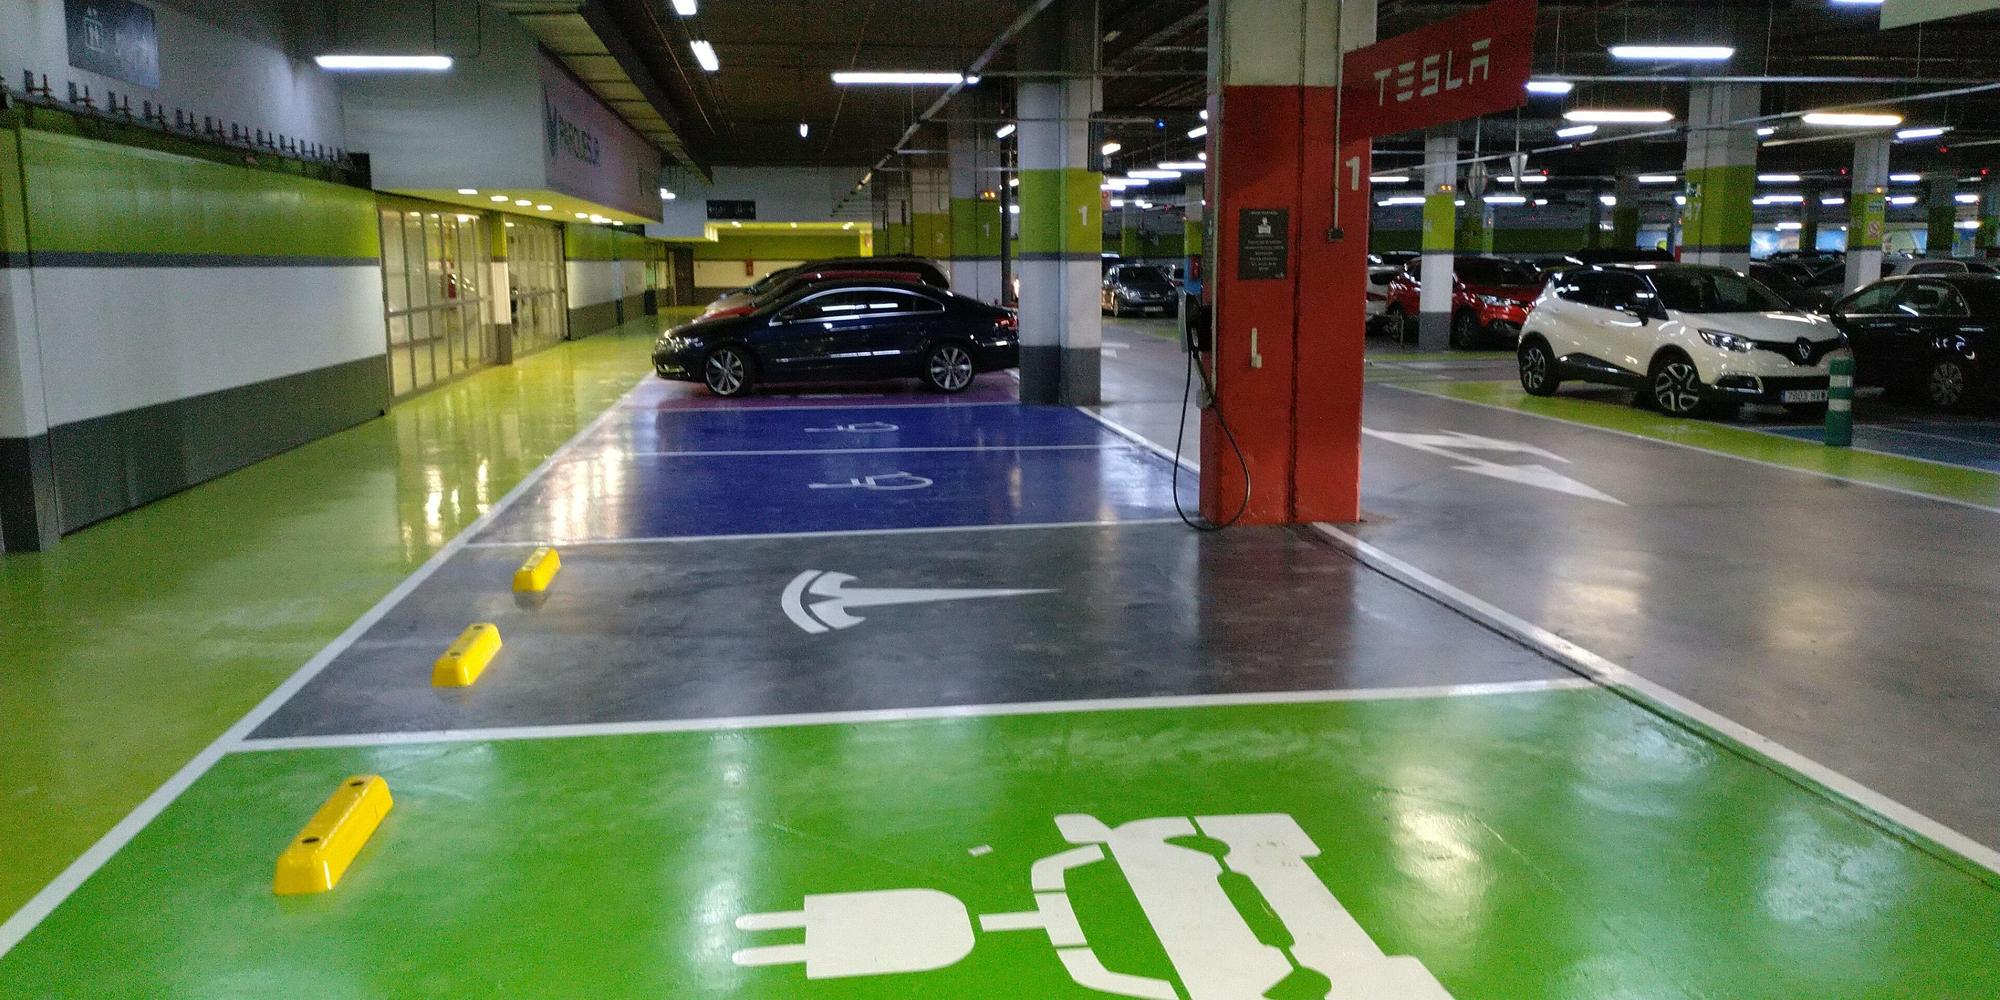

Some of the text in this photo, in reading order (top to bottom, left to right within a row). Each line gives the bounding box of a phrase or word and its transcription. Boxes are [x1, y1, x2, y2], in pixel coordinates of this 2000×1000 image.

[1373, 38, 1492, 107] TESLA
[1345, 156, 1361, 191] 1
[1078, 205, 1088, 227] 1
